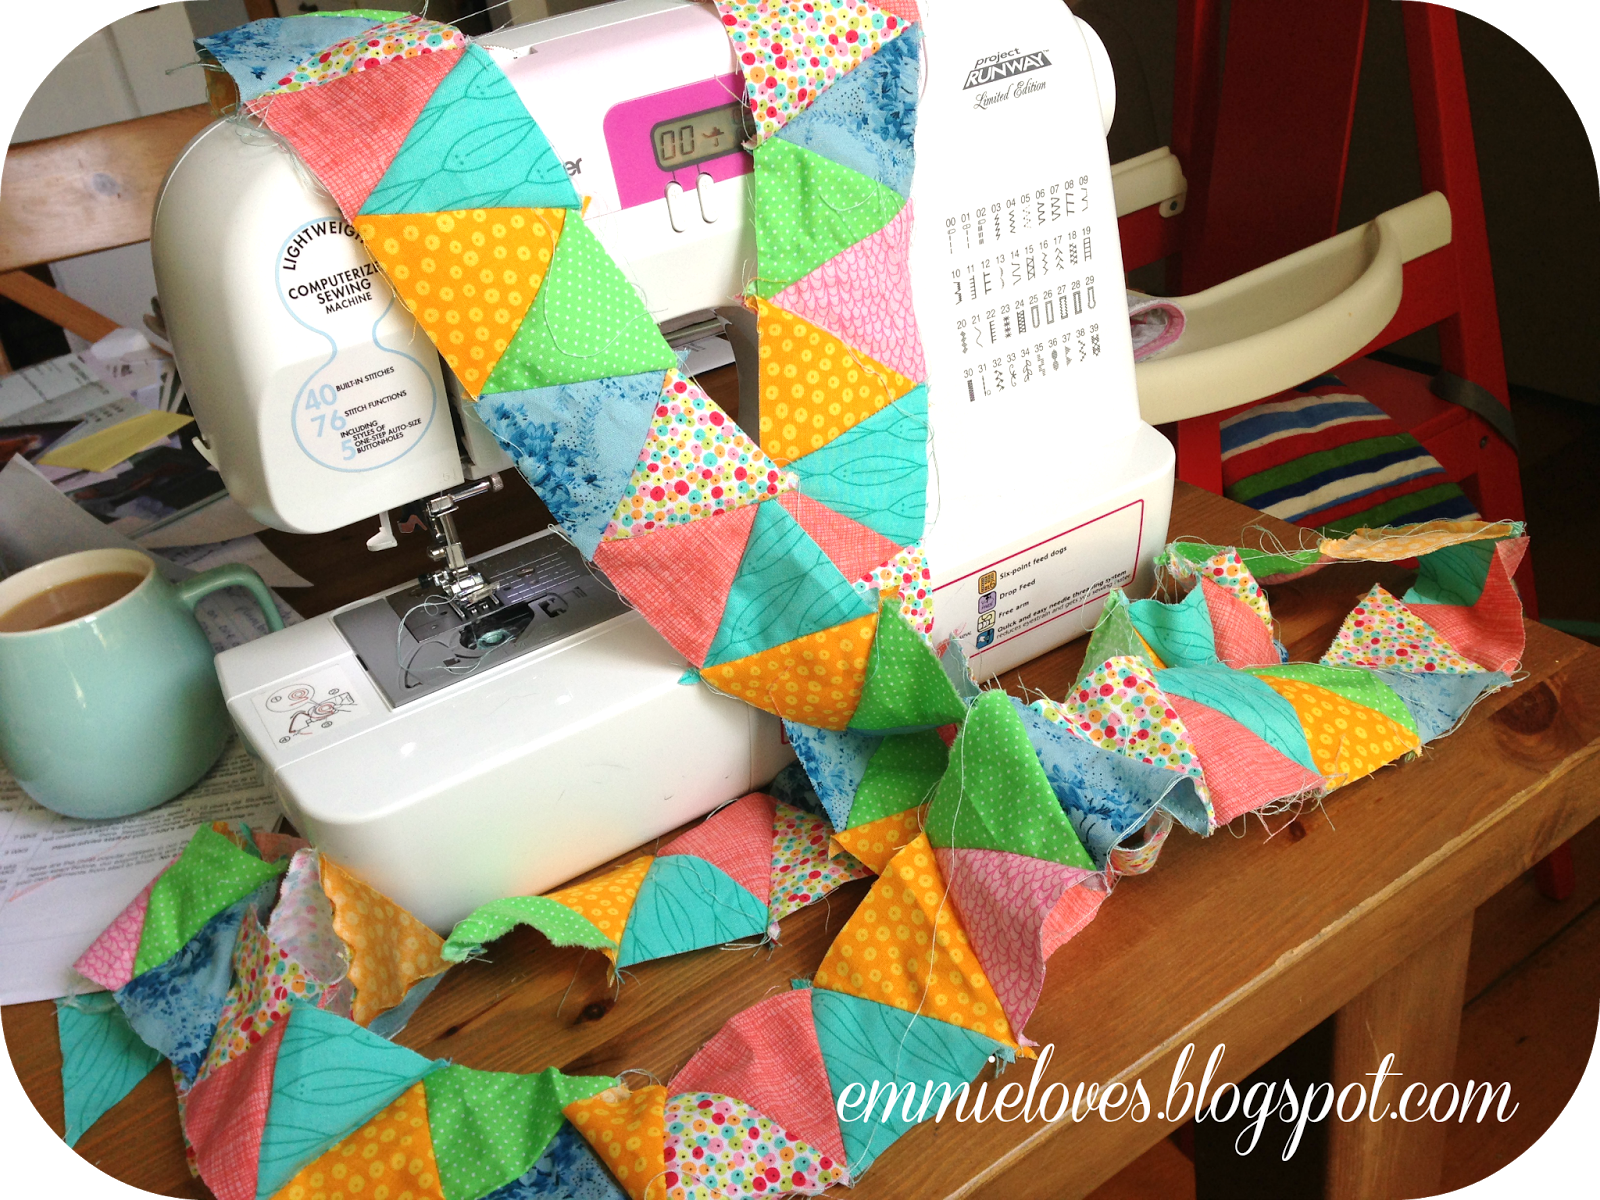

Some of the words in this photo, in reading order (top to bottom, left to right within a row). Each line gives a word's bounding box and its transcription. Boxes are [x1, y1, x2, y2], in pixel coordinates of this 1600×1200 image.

[964, 52, 1046, 88] RUNWAY
[974, 48, 1021, 69] project
[973, 83, 1014, 110] Limited
[1013, 77, 1046, 98] Edition
[946, 217, 956, 227] 00
[961, 212, 970, 223] 01
[976, 207, 986, 218] 02
[991, 202, 1001, 213] 03
[1006, 198, 1016, 208] 04
[1020, 193, 1030, 204] 05
[1035, 189, 1045, 199] 06
[1050, 184, 1059, 194] 07
[1064, 179, 1074, 190] 08
[1079, 175, 1089, 185] 09
[951, 268, 961, 278] 10
[967, 264, 975, 273] 11
[981, 259, 990, 268] 12
[996, 254, 1005, 264] 13
[1011, 249, 1020, 259] 14
[1025, 244, 1034, 254] 15
[1039, 240, 1048, 250] 16
[1053, 235, 1062, 245] 17
[1068, 230, 1077, 240] 18
[1082, 226, 1091, 236] 19
[316, 278, 372, 305] SEWING
[325, 291, 373, 315] MACHINE
[957, 319, 967, 330] 20
[971, 314, 981, 324] 21
[986, 309, 996, 319] 22
[1000, 304, 1010, 315] 23
[1015, 299, 1025, 309] 24
[1029, 294, 1038, 305] 25
[1043, 289, 1053, 300] 26
[1057, 284, 1066, 295] 27
[1071, 280, 1081, 290] 28
[1085, 275, 1095, 286] 29
[963, 368, 974, 379] 30
[978, 363, 987, 373] 31
[992, 358, 1002, 368] 32
[1006, 353, 1017, 363] 33
[1021, 348, 1030, 358] 34
[1034, 343, 1044, 353] 35
[1048, 338, 1058, 348] 36
[1062, 333, 1071, 343] 37
[1075, 328, 1085, 338] 38
[1089, 323, 1099, 334] 39
[305, 383, 338, 411] 40
[335, 376, 364, 392] BUILT-IN
[364, 366, 395, 382] STITCHES
[310, 409, 347, 438] 76
[344, 404, 367, 417] STITCH
[368, 389, 407, 408] FUNCTIONS
[340, 420, 378, 438] INCLUDING
[341, 439, 357, 461] 5
[352, 428, 375, 441] STYLES
[376, 424, 386, 432] OF
[354, 431, 387, 447] ONE-STEP
[388, 418, 422, 435] AUTO-SIZE
[356, 432, 404, 454] BUTTONHOLES
[999, 561, 1031, 580] Six-point
[1033, 553, 1049, 566] feed
[1050, 545, 1067, 558] dogs
[999, 587, 1018, 601] Drop
[1019, 579, 1036, 591] Feed
[997, 619, 1017, 633] Quick
[1018, 613, 1032, 623] and
[1033, 607, 1048, 618] easy
[1049, 595, 1071, 610] needle
[998, 608, 1014, 618] Free
[1016, 600, 1030, 610] arm
